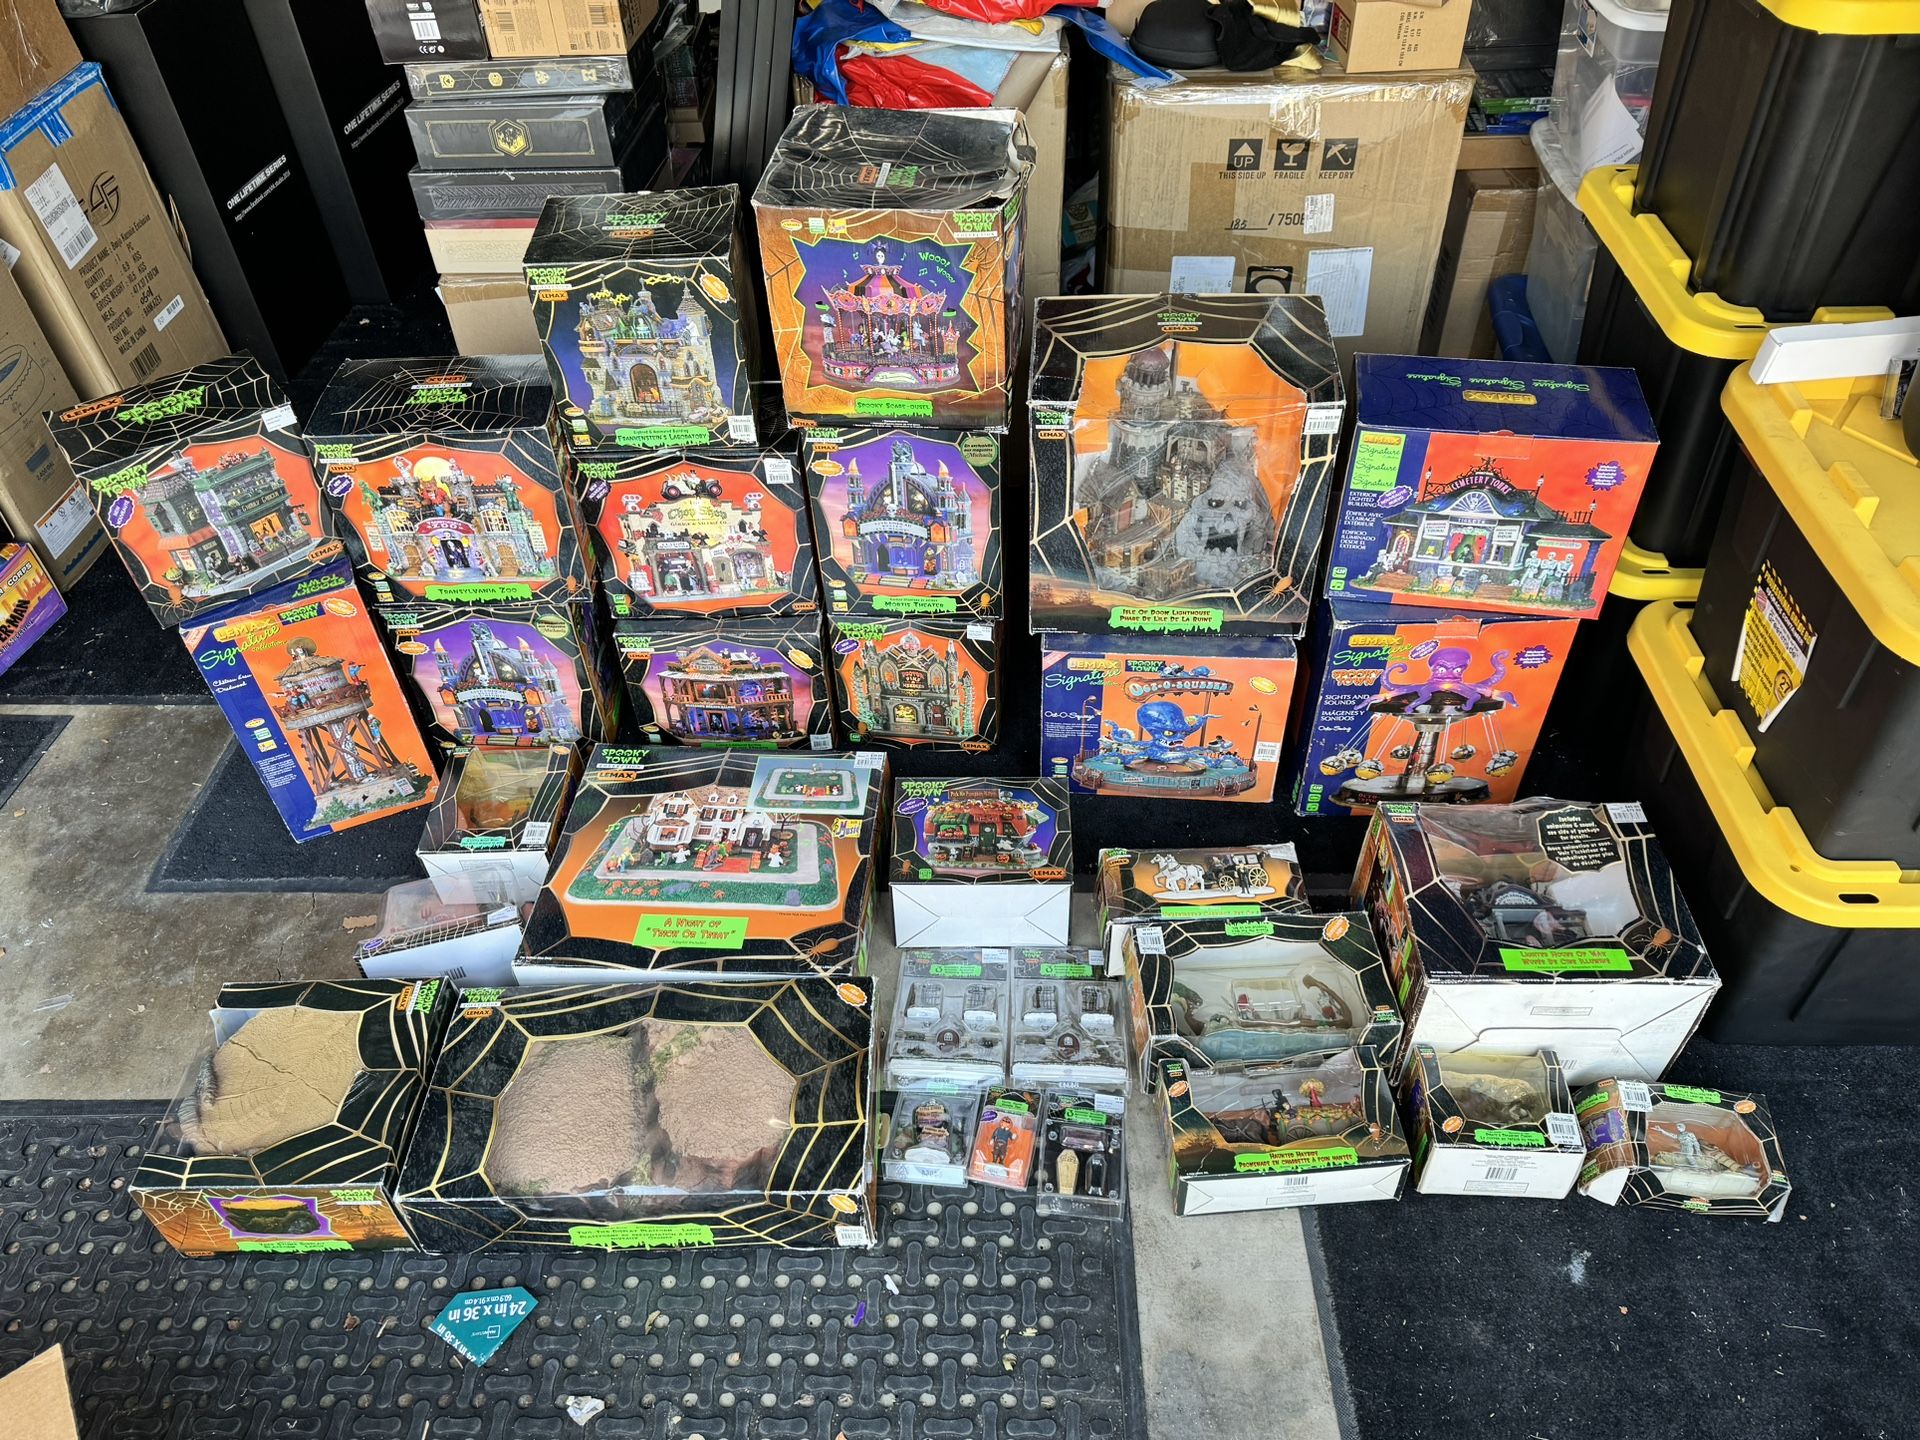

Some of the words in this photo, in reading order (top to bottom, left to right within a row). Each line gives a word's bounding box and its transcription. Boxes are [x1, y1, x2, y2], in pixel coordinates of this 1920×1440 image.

[344, 119, 357, 135] ONE
[356, 97, 382, 124] LIFETIME
[381, 80, 400, 101] SERIES
[1234, 157, 1253, 168] UP
[227, 195, 241, 210] ONE
[239, 172, 266, 199] LIFETIME
[265, 155, 286, 177] SERIES
[605, 212, 669, 222] SPOOKY
[953, 213, 998, 224] SPOOKY
[959, 223, 993, 232] TOWN
[84, 267, 106, 290] QUANTITY
[127, 242, 135, 252] PC
[527, 268, 568, 276] SPOOKY
[90, 286, 101, 300] NET
[99, 274, 115, 295] WEIGHT
[132, 253, 142, 264] KGS
[533, 276, 567, 284] TOWN
[96, 294, 113, 312] GROSS
[110, 280, 126, 299] WEIGHT
[137, 263, 148, 275] KGS
[106, 315, 125, 334] PRODUCT
[118, 340, 131, 356] MADE
[130, 336, 136, 345] IN
[134, 325, 148, 340] CHINA
[1407, 372, 1461, 387] Signature
[1469, 377, 1525, 392] Signature
[1531, 379, 1591, 393] Signature
[65, 397, 121, 419] LEMAX
[116, 385, 206, 422] SPOOKY
[132, 397, 202, 426] TOWN
[1035, 411, 1069, 419] SPOOKY
[809, 430, 839, 438] TOWN
[314, 444, 353, 452] SPOOKY
[1359, 444, 1400, 457] Signature
[321, 451, 352, 459] TOWN
[577, 463, 618, 471] SPOOKY
[1356, 460, 1396, 473] Signature
[91, 462, 148, 491] SPOOKY
[585, 470, 617, 479] TOWN
[105, 474, 148, 498] TOWN
[1352, 476, 1393, 488] Signature
[1452, 475, 1489, 490] CEMETERY
[1490, 478, 1513, 495] TOURS
[310, 543, 340, 560] LEMAX
[500, 586, 518, 594] ZOO
[217, 617, 277, 641] LEMAX
[279, 603, 320, 621] SPOOKY
[288, 612, 319, 624] TOWN
[384, 613, 418, 621] SPOOKY
[838, 622, 887, 633] SPOOKY
[845, 631, 884, 641] TOWN
[1350, 636, 1402, 647] LEMAX
[199, 625, 280, 670] Signature
[1333, 643, 1413, 667] Signature
[1069, 660, 1119, 669] LEMAX
[1045, 669, 1122, 691] Signature
[1780, 677, 1792, 694] 27
[601, 749, 650, 757] SPOOKY
[606, 756, 641, 764] TOWN
[600, 771, 633, 780] LEMAX
[901, 782, 947, 790] SPOOKY
[664, 918, 672, 927] A
[676, 918, 706, 928] NIGHT
[709, 920, 721, 928] OF
[682, 929, 696, 938] OR
[422, 980, 440, 1014] SPOOKY
[467, 995, 498, 1003] TOWN
[464, 1307, 480, 1322] 36
[484, 1306, 491, 1316] x
[495, 1303, 507, 1317] in
[510, 1301, 527, 1316] 24
[448, 1308, 461, 1323] in
[437, 1323, 446, 1335] in
[443, 1331, 455, 1344] 36
